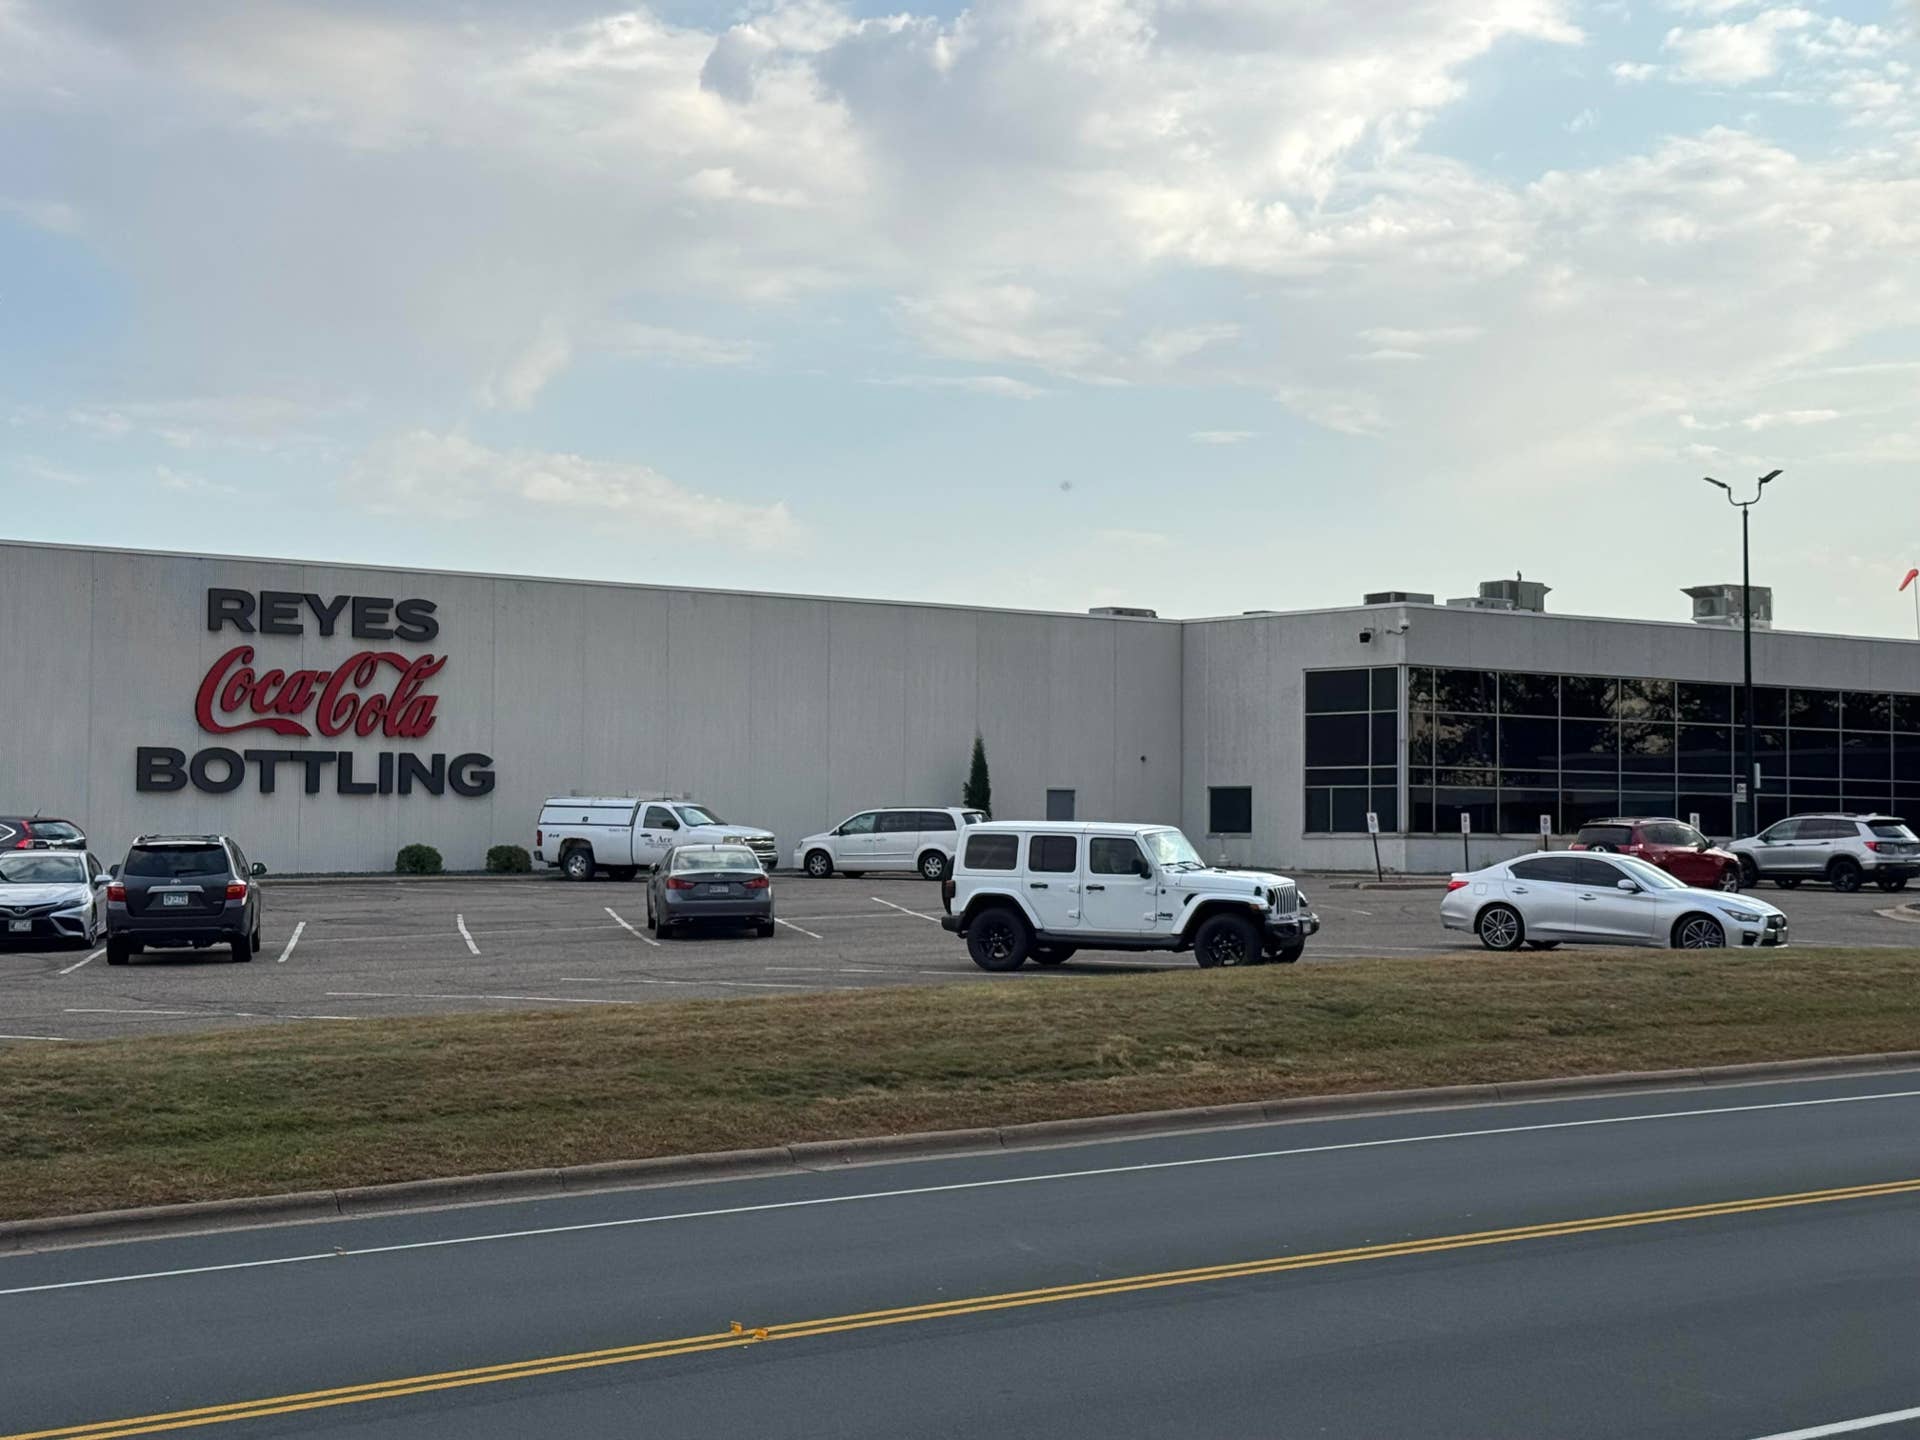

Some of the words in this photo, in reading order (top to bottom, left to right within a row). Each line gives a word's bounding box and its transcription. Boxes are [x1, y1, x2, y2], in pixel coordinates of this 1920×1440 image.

[207, 587, 440, 642] REYES
[195, 645, 448, 738] Coca-Cola
[136, 746, 496, 797] BOTTLING
